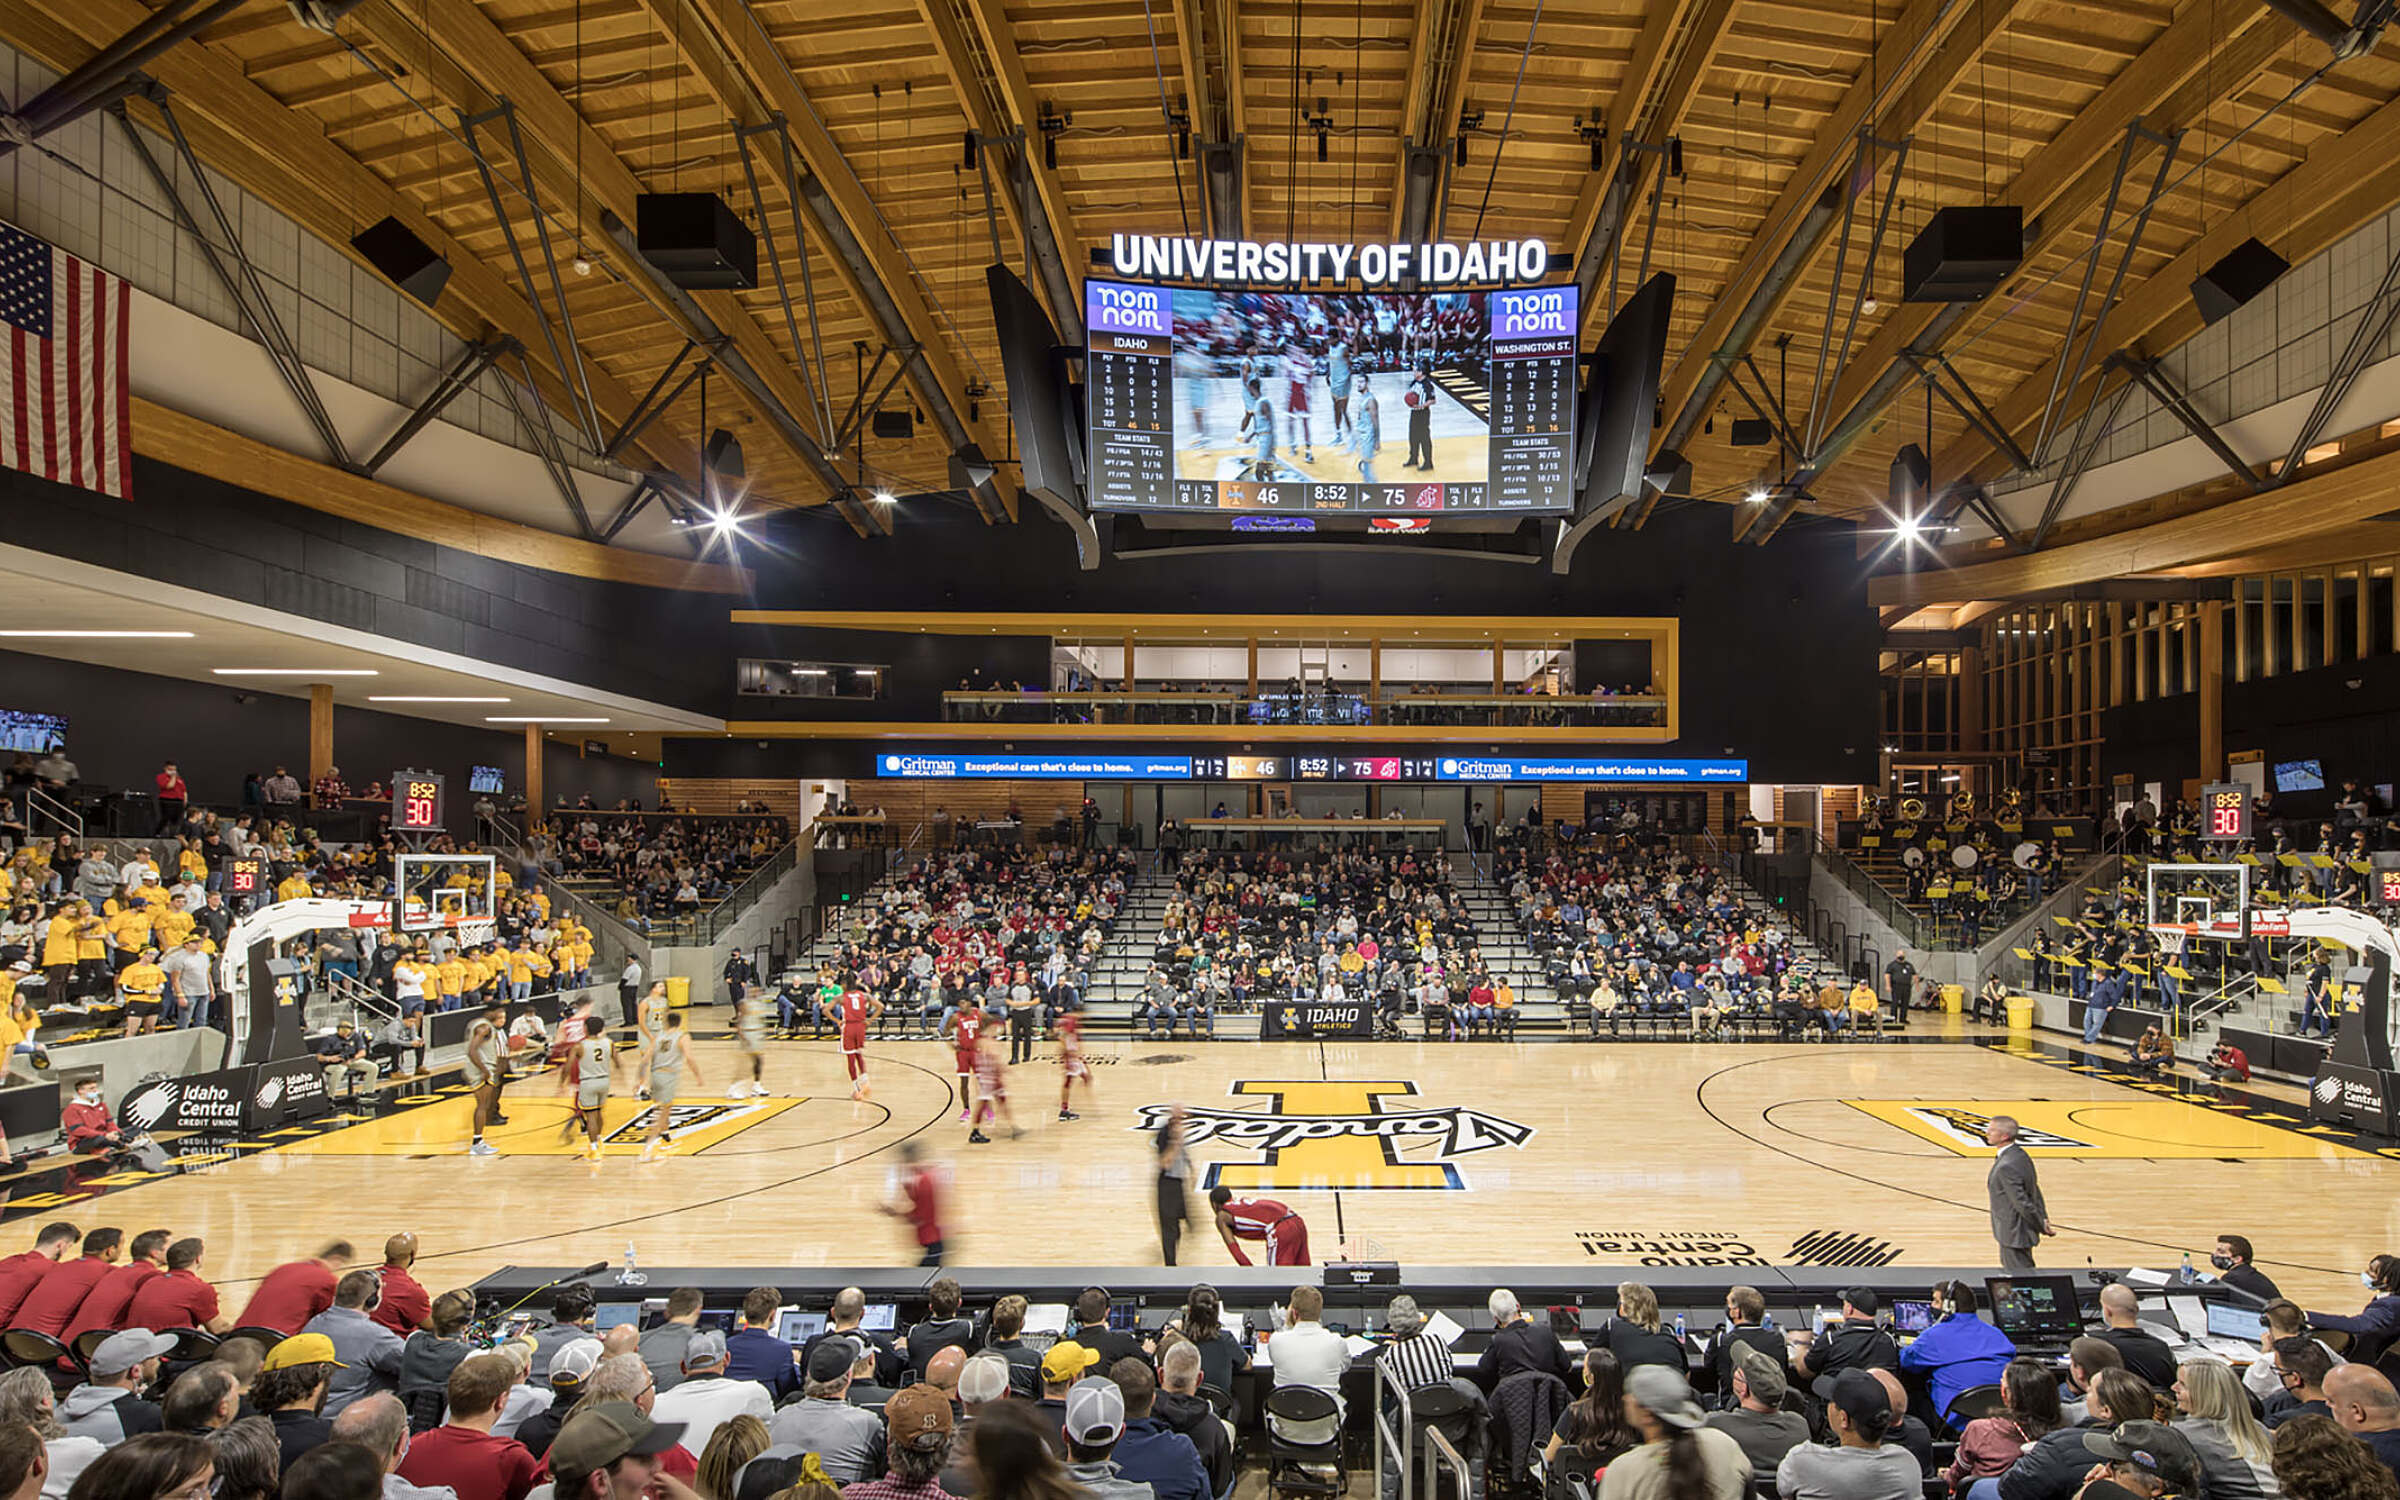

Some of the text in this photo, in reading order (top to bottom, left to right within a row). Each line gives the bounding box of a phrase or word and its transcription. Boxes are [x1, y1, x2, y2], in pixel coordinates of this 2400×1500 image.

[1112, 233, 1548, 283] UNIVERSITY OF IDAHO
[1097, 287, 1158, 310] nom
[1502, 294, 1562, 314] nom
[1103, 307, 1163, 331] nom
[1506, 312, 1566, 332] nom
[1114, 337, 1148, 349] IDAHO
[1495, 341, 1571, 354] WASHINGTON ST.
[1528, 371, 1537, 379] 12
[1182, 488, 1278, 504] 8 2 46
[1314, 486, 1347, 500] 8:52
[1383, 489, 1405, 505] 75
[1451, 495, 1480, 506] 3 4
[900, 758, 956, 772] Gritman
[965, 762, 1018, 773] Exceptional
[1020, 764, 1039, 772] care
[1041, 763, 1066, 772] that's
[1068, 763, 1091, 772] close
[1092, 764, 1103, 772] to
[1104, 763, 1133, 773] home.
[1215, 767, 1222, 775] 2
[1256, 761, 1274, 774] 46
[1300, 759, 1328, 771] 8:52
[1353, 762, 1372, 775] 75
[1406, 767, 1431, 776] 3 4
[1456, 761, 1511, 775] Gritman
[1521, 765, 1574, 776] Exceptional
[1576, 767, 1595, 775] care
[1597, 765, 1622, 775] that's
[1623, 766, 1646, 775] close
[1648, 766, 1658, 775] to
[1658, 766, 1688, 776] home.
[409, 782, 436, 799] 8:52
[2216, 792, 2242, 808] 8:52
[406, 799, 432, 824] 30
[2214, 809, 2239, 835] 30
[234, 861, 259, 873] 8:52
[234, 873, 253, 890] 30
[1307, 1008, 1359, 1022] IDAHO
[594, 1048, 603, 1061] 2
[286, 1073, 314, 1086] Idaho
[286, 1079, 323, 1095] Central
[182, 1085, 229, 1100] Idaho
[2344, 1080, 2372, 1095] Idaho
[2344, 1090, 2381, 1106] Central
[179, 1100, 241, 1117] Central
[177, 1118, 239, 1127] CREDIT UNION
[1582, 1241, 1756, 1256] Central
